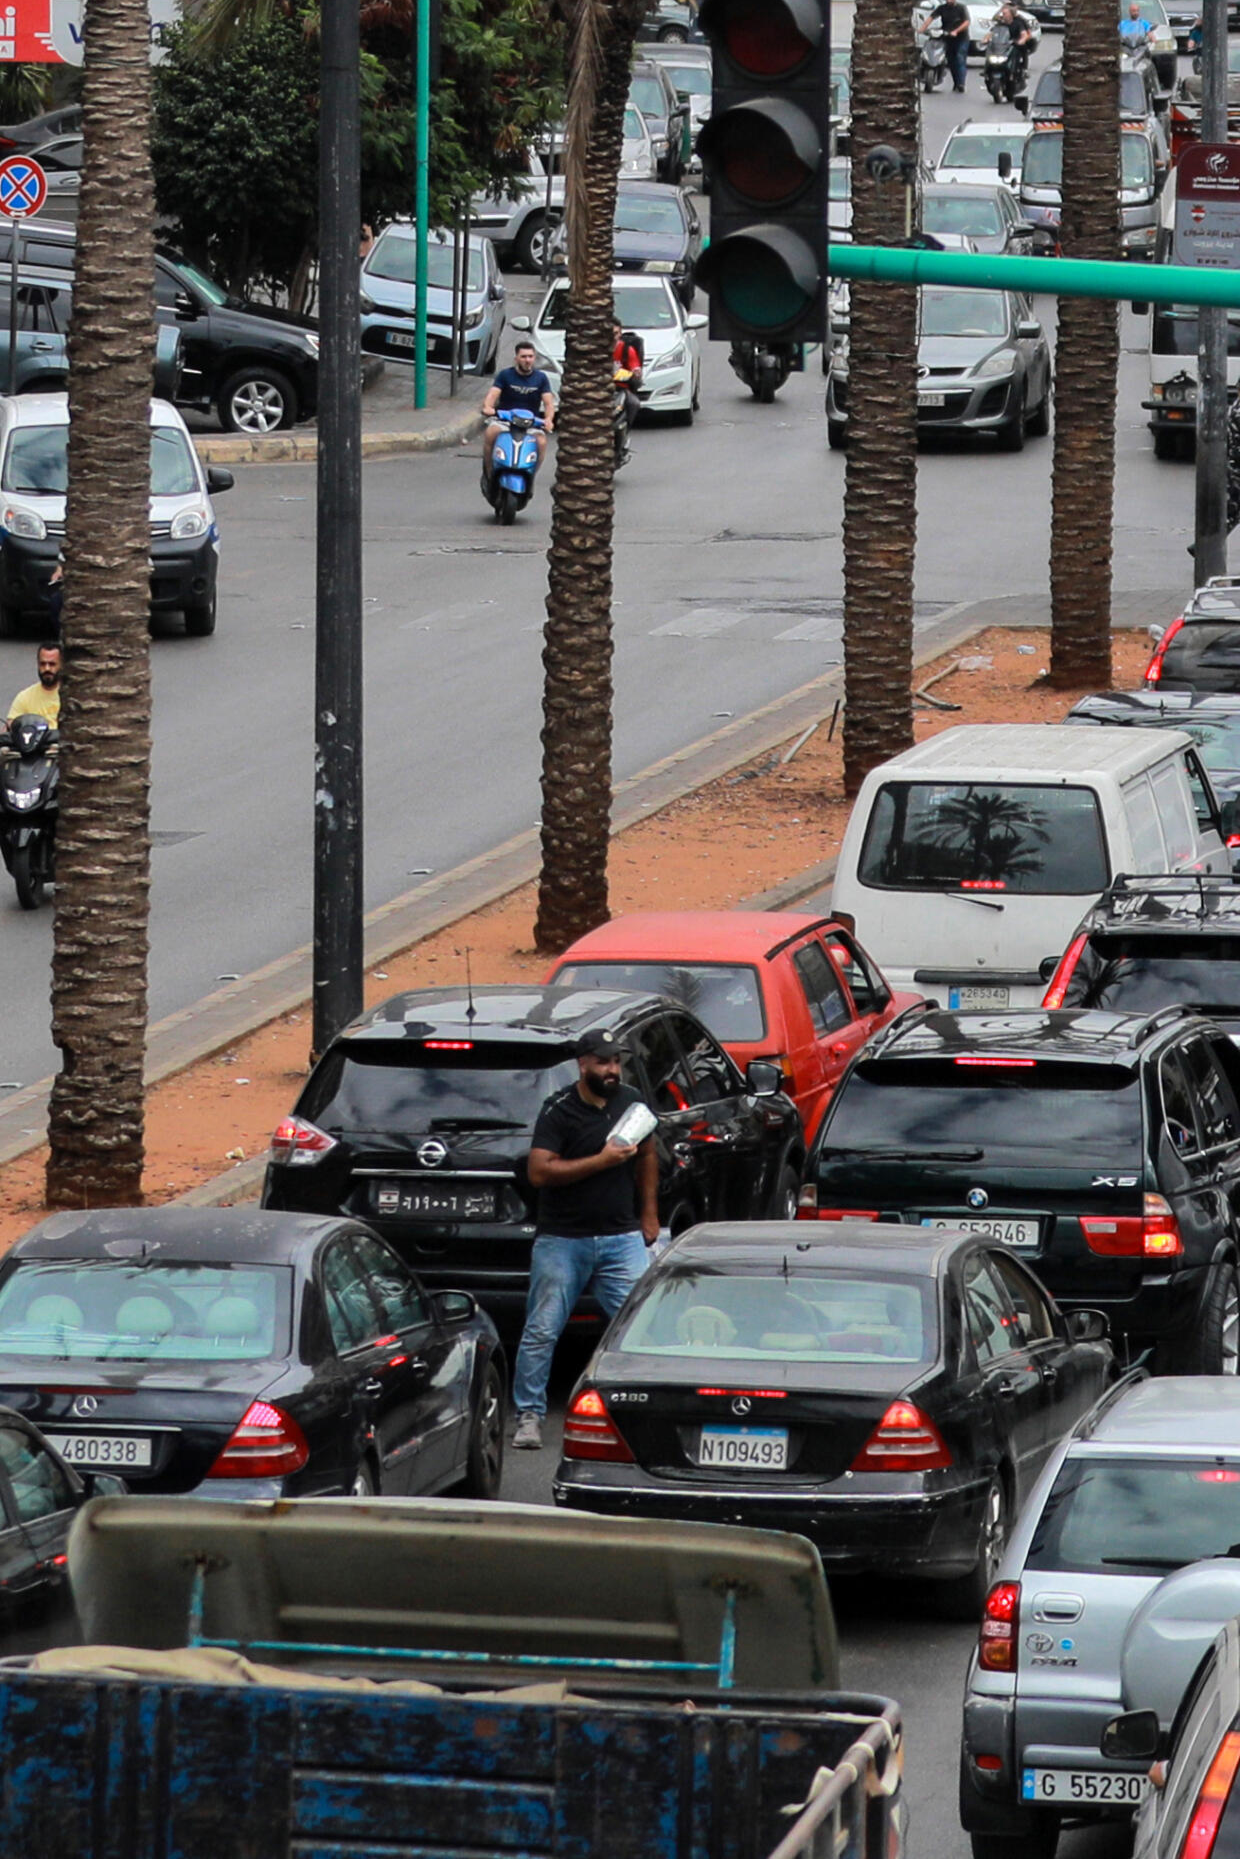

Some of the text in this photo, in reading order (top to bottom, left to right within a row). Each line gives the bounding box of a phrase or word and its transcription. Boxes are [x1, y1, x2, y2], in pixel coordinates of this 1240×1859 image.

[1091, 1176, 1138, 1187] X5
[62, 1439, 137, 1461] 480338
[702, 1439, 785, 1464] N109493
[1042, 1773, 1147, 1800] G 55230
